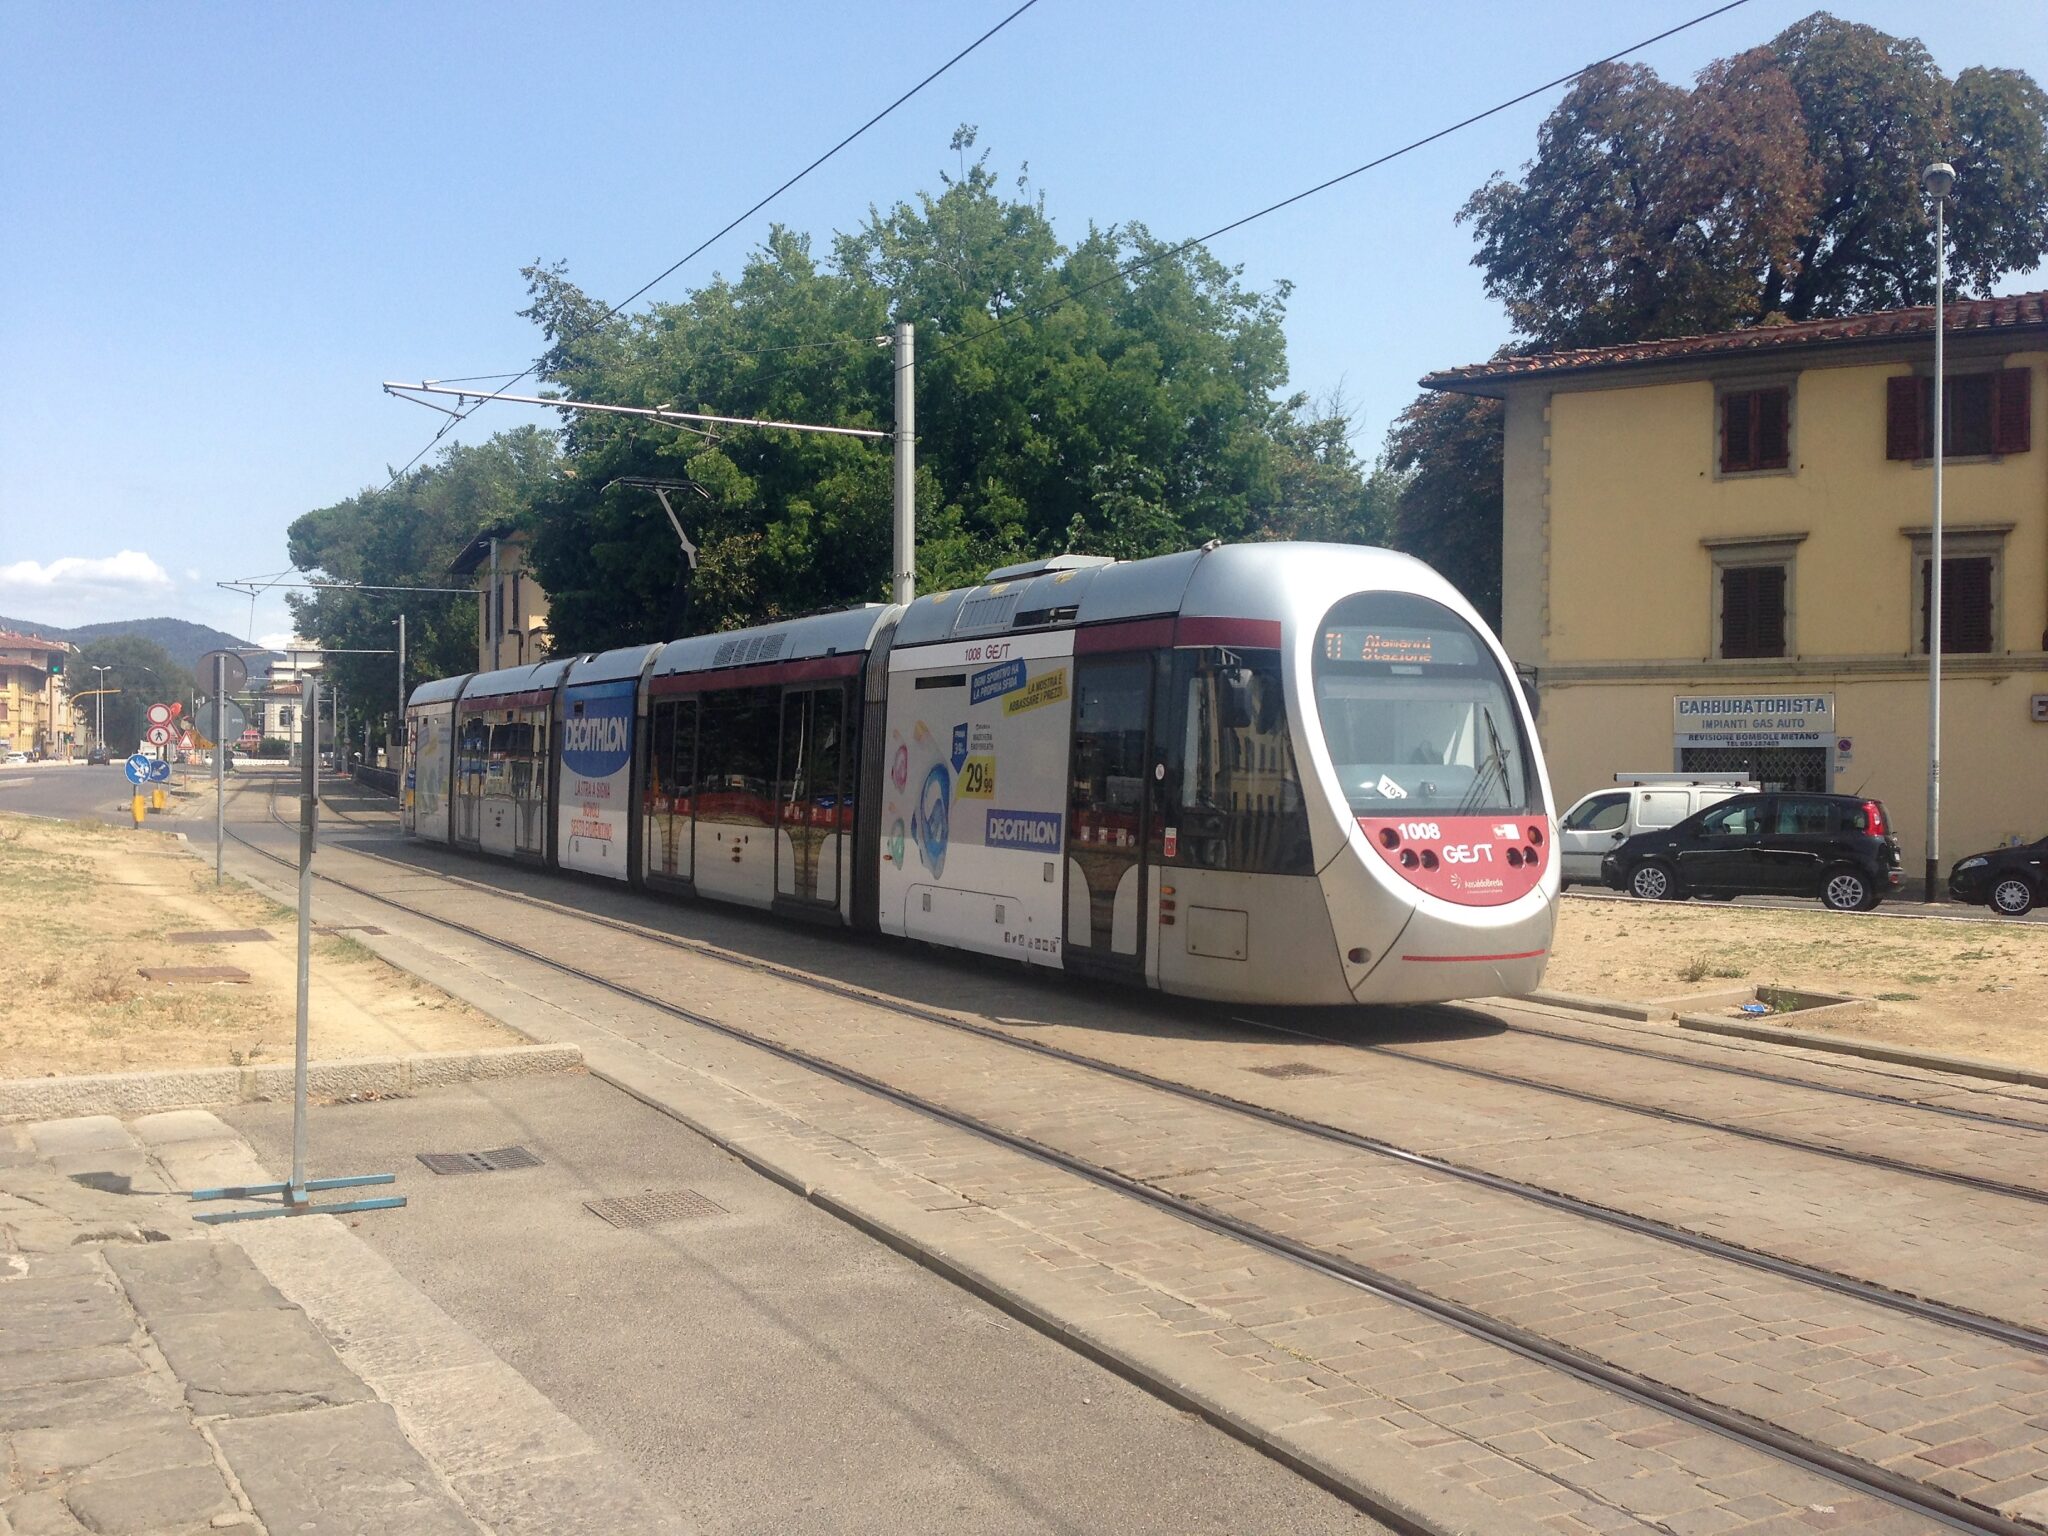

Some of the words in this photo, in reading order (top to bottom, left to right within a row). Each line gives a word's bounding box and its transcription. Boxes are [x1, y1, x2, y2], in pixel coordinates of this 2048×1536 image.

[965, 647, 981, 662] 1008
[985, 643, 1011, 660] GEST
[1325, 633, 1342, 659] T1
[1035, 675, 1058, 691] NOSTRA
[1008, 693, 1040, 712] ABBASSARE
[1679, 698, 1826, 715] CARBURATORISTA
[1702, 719, 1747, 729] IMPIANTI
[1752, 718, 1773, 729] GAS
[1777, 718, 1805, 728] AUTO
[565, 717, 628, 752] DECATHLON
[1688, 733, 1734, 741] REVISIONE
[1735, 733, 1779, 741] BOMBOLE
[966, 762, 983, 793] 29
[984, 778, 993, 793] 99
[989, 817, 1057, 845] DECATHLON
[1398, 823, 1441, 840] 1008
[1442, 843, 1493, 864] GEST
